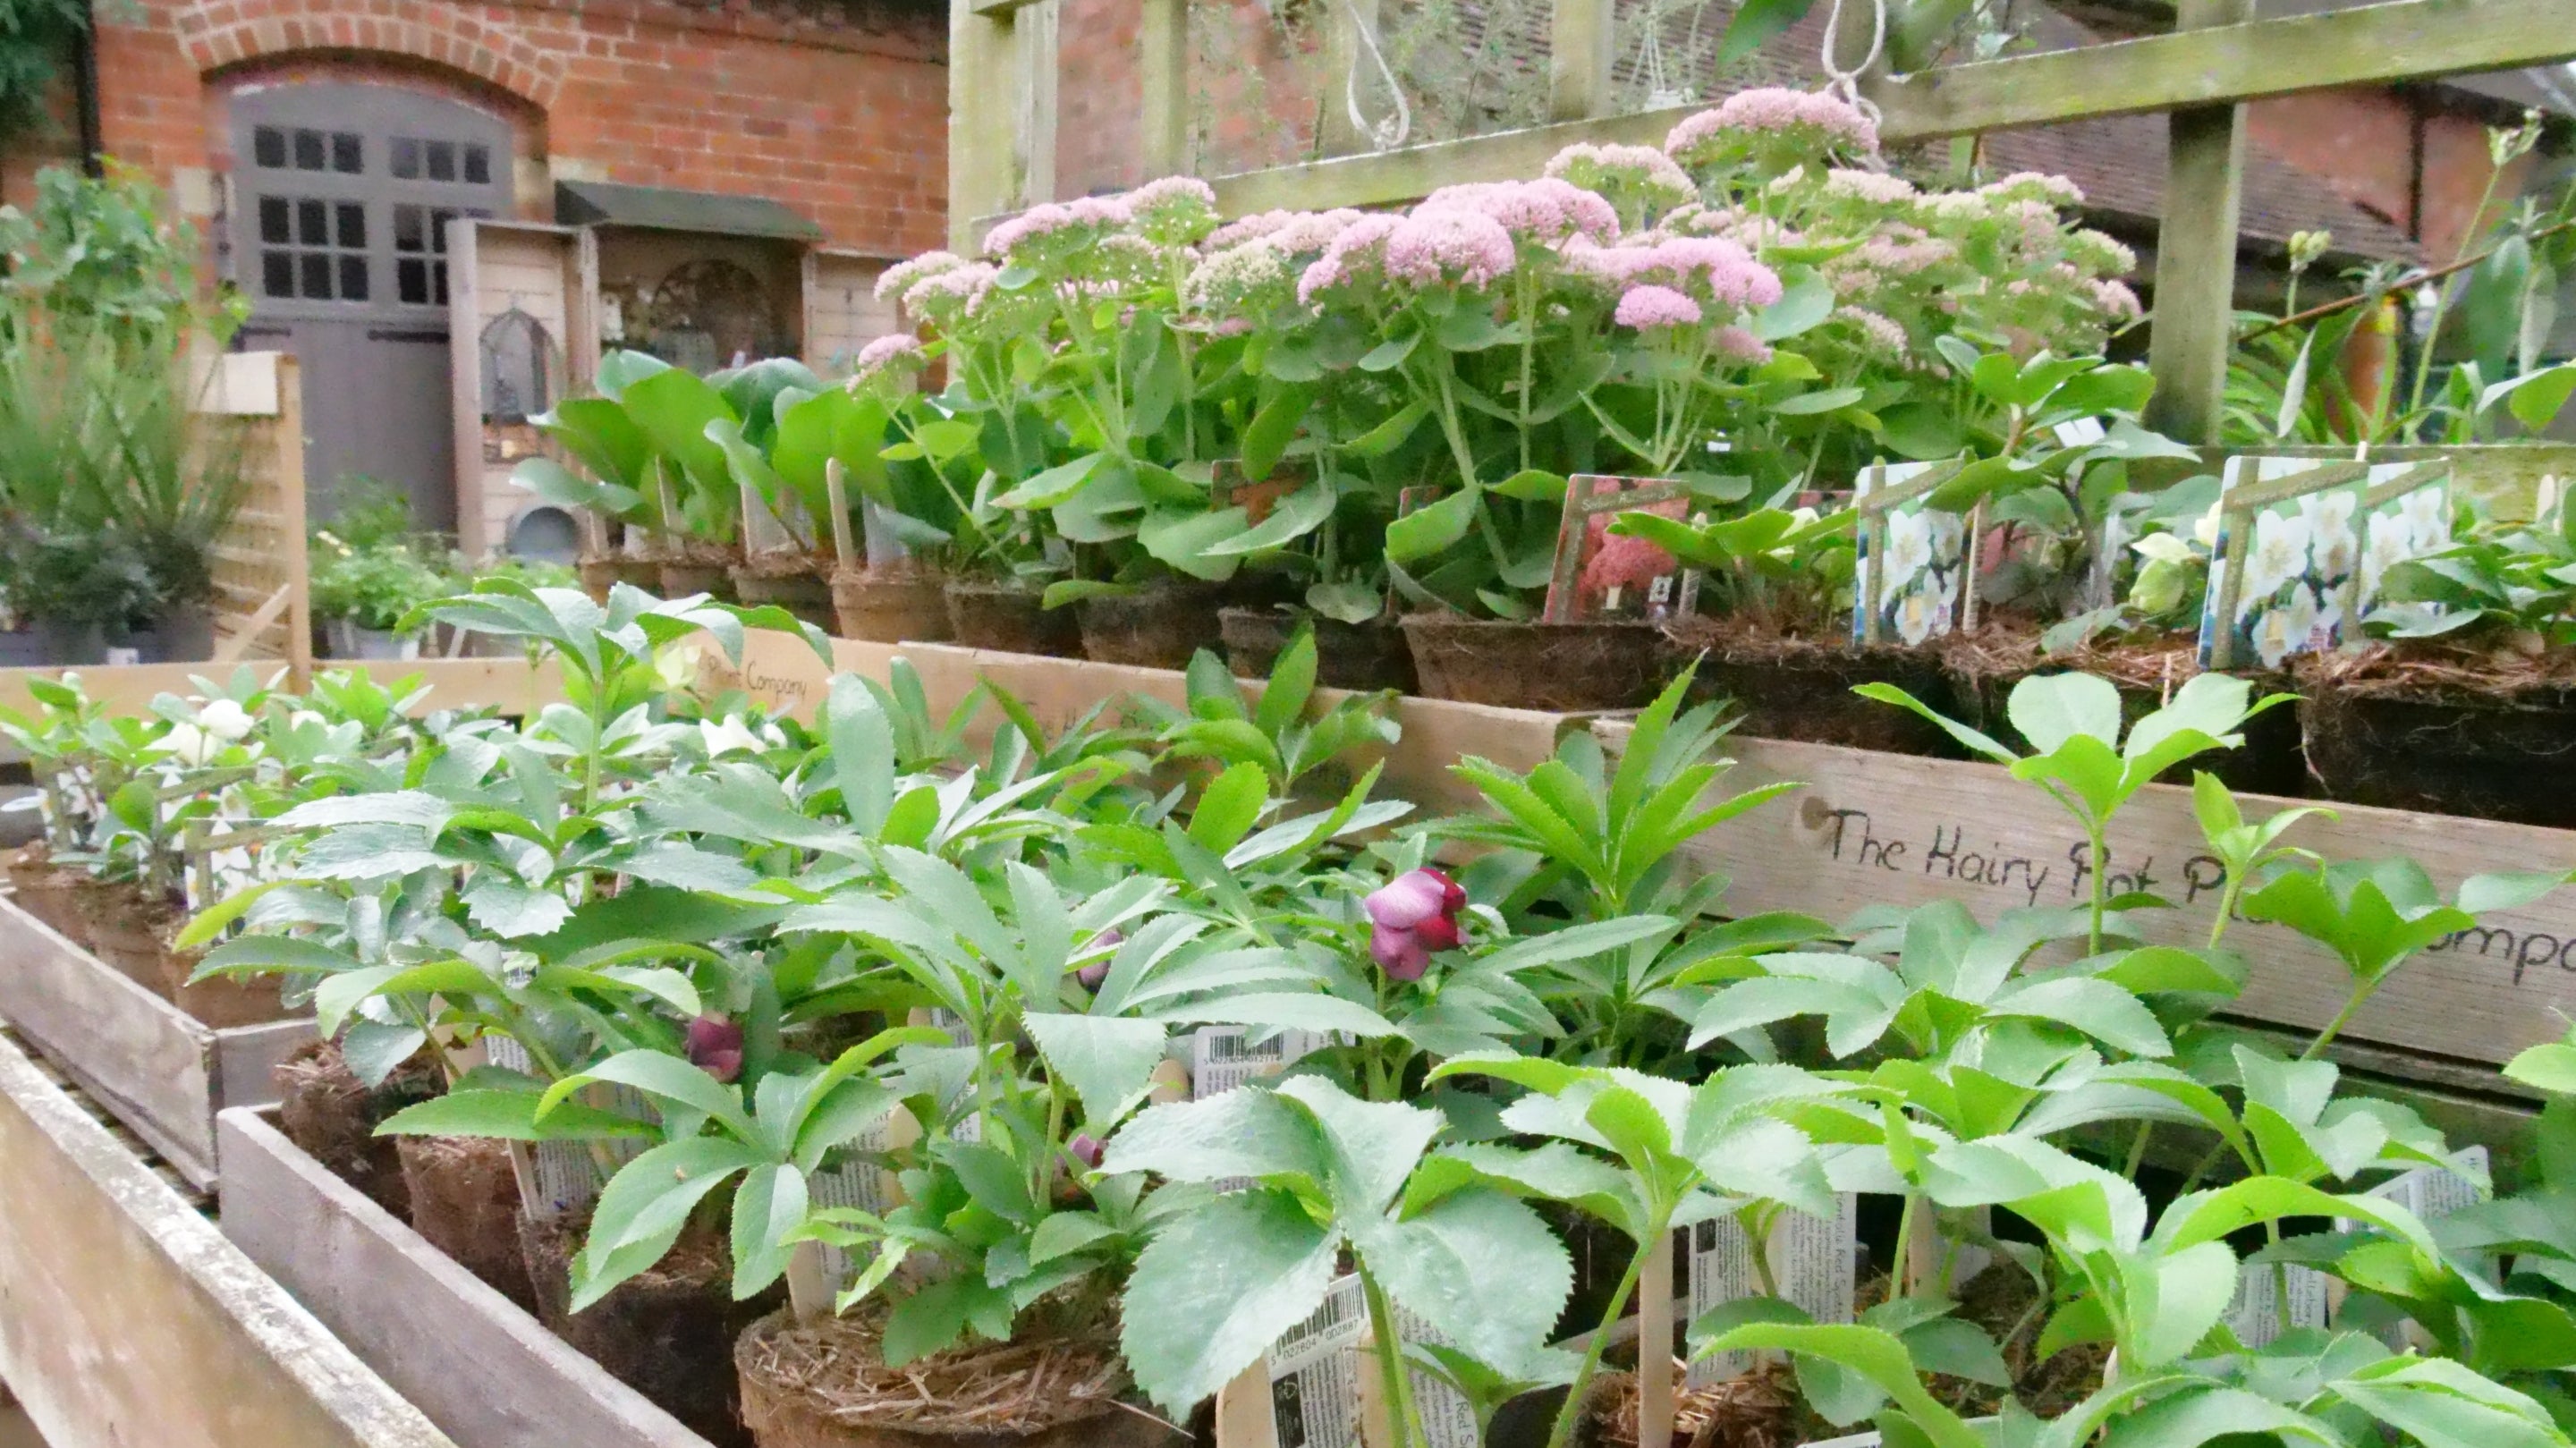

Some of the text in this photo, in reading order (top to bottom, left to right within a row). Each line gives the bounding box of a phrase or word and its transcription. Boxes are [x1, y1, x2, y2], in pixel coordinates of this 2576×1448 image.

[746, 660, 809, 704] Company
[1826, 809, 1908, 872] The
[1926, 821, 2049, 908] Hairy
[1459, 1434, 1475, 1448] S
